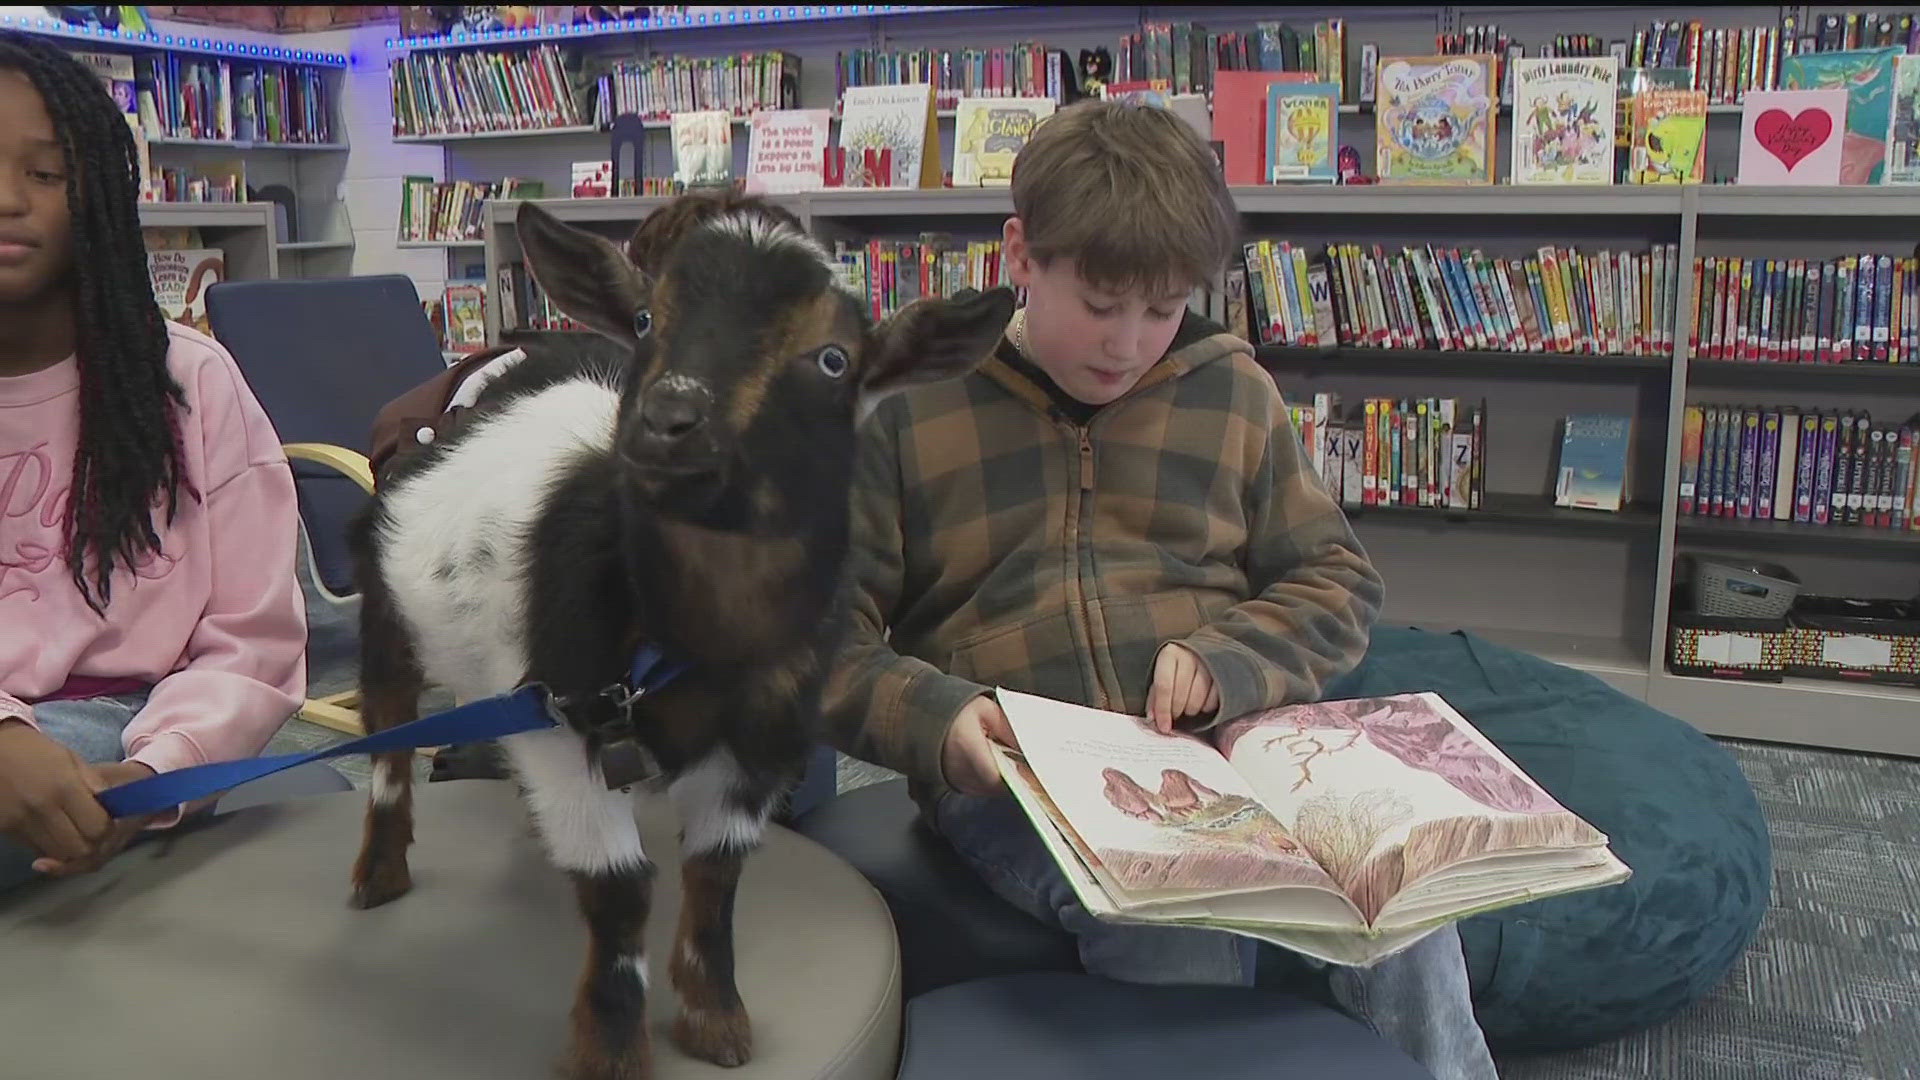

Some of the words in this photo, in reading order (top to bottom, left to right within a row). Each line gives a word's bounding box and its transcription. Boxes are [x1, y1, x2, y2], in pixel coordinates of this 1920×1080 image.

[1522, 66, 1546, 84] Dirty
[1549, 62, 1590, 77] Laundry
[1592, 65, 1612, 84] Pile
[853, 97, 876, 106] Emily
[877, 96, 920, 105] Dickinson
[1283, 100, 1327, 109] WEATHER
[782, 126, 813, 137] World
[1777, 124, 1810, 140] Happy
[758, 151, 798, 162] Explore
[1782, 144, 1801, 157] Day
[755, 163, 777, 174] Line
[153, 252, 172, 265] How
[173, 252, 186, 264] Do
[153, 272, 177, 284] Learn
[178, 273, 187, 284] to
[500, 277, 511, 294] N
[1229, 280, 1243, 299] V
[1310, 281, 1328, 302] W
[1328, 437, 1339, 457] X
[1348, 439, 1360, 459] Y
[1456, 445, 1468, 465] Z
